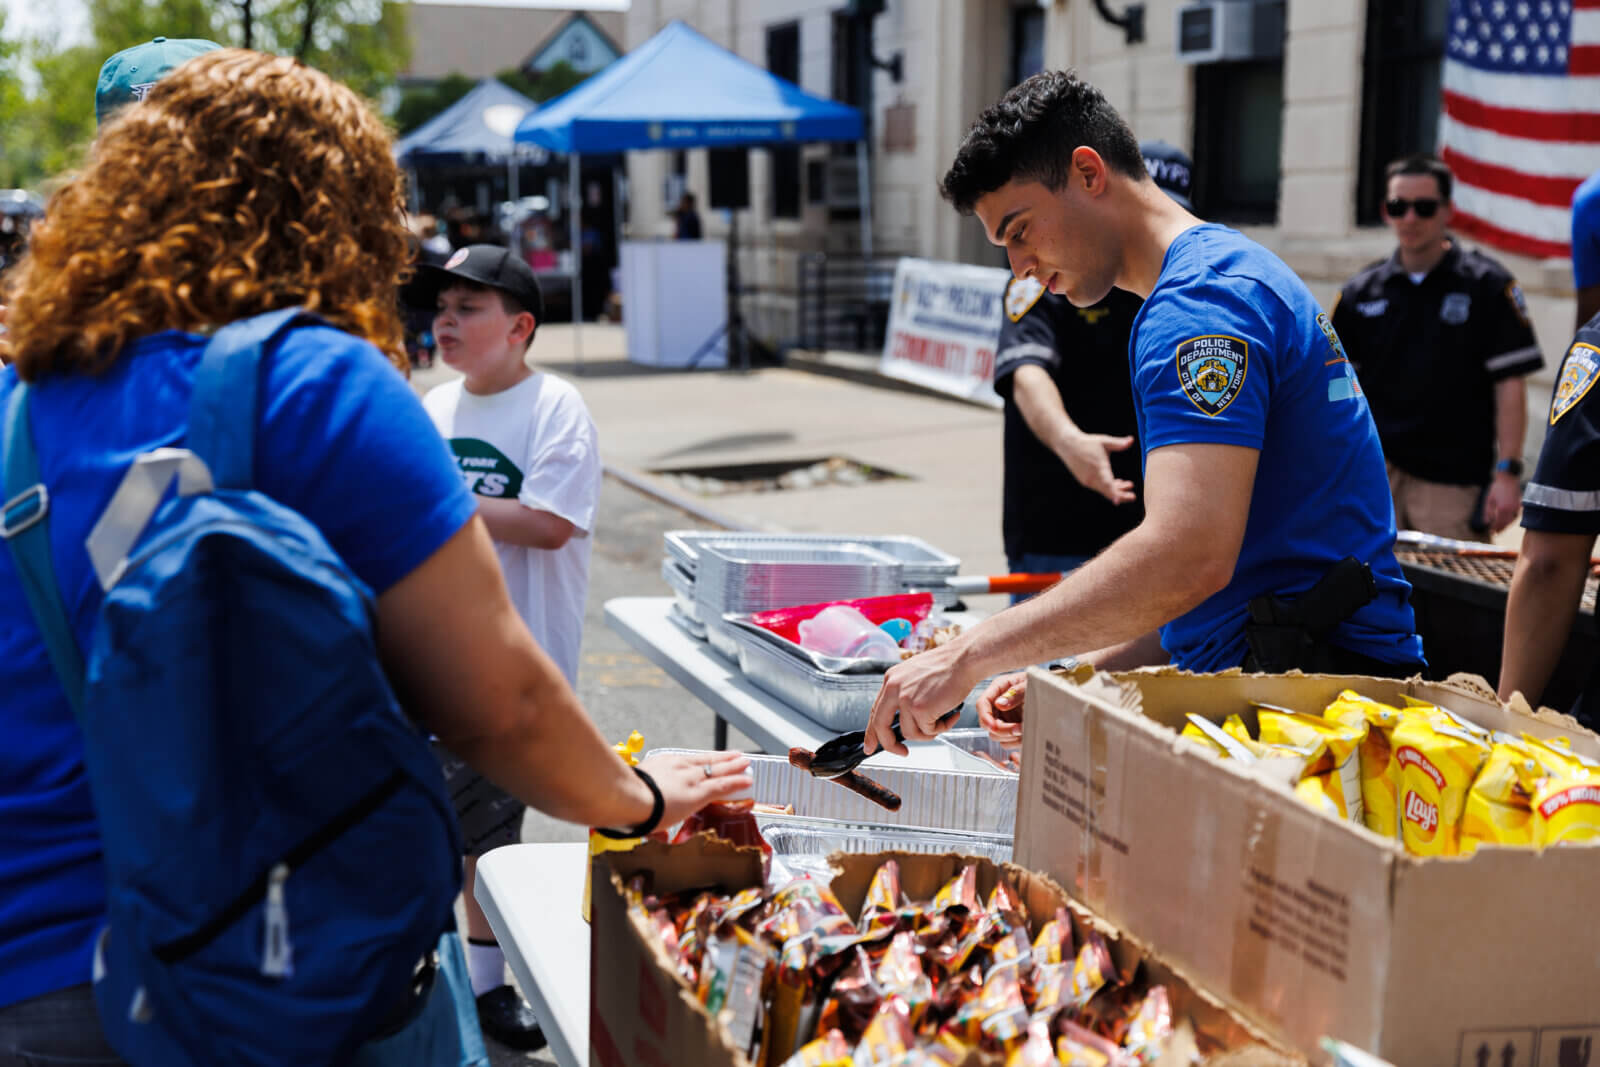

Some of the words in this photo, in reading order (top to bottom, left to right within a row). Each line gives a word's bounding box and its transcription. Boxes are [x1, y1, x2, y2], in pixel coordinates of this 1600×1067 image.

[1180, 347, 1244, 366] DEPARTMENT
[1193, 338, 1231, 350] POLICE
[1181, 372, 1194, 390] CITY
[1191, 392, 1204, 403] OF
[1216, 391, 1233, 409] NEW
[1230, 368, 1244, 390] YORK
